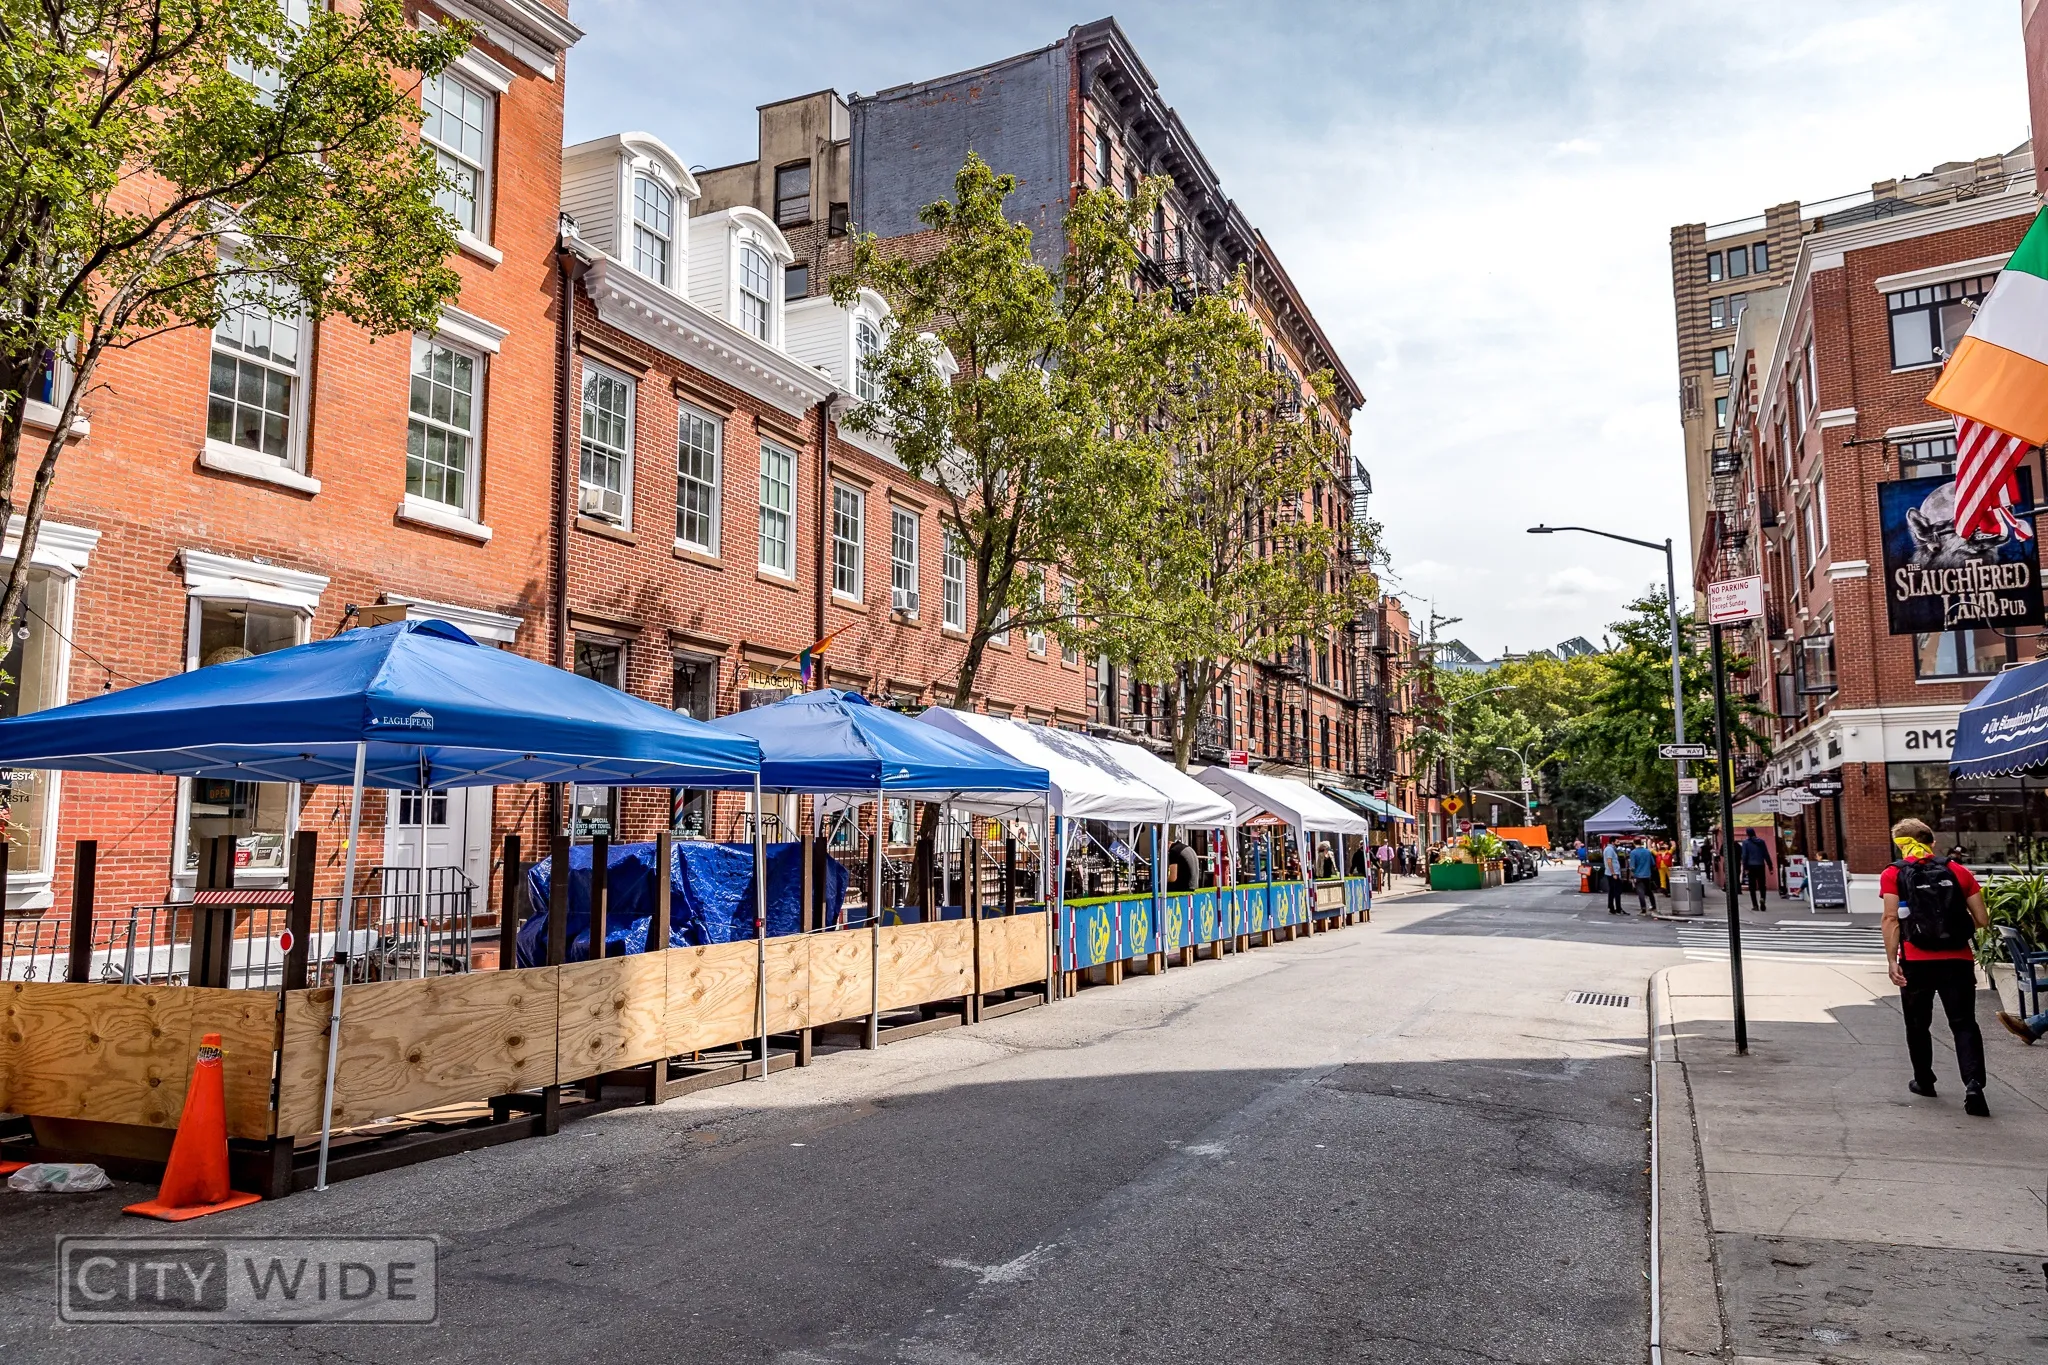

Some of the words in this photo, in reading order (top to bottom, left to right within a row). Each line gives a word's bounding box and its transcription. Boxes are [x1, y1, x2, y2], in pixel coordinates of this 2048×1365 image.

[1906, 563, 1921, 571] THE
[1895, 558, 2030, 601] SLAUGHTERED
[1721, 582, 1749, 593] PARKING
[1712, 602, 1728, 610] Except
[1729, 600, 1747, 608] Sunday
[1941, 592, 1999, 625] LAMB
[1999, 597, 2027, 616] PUB
[1, 771, 34, 780] WEST4
[209, 788, 230, 799] OPEN
